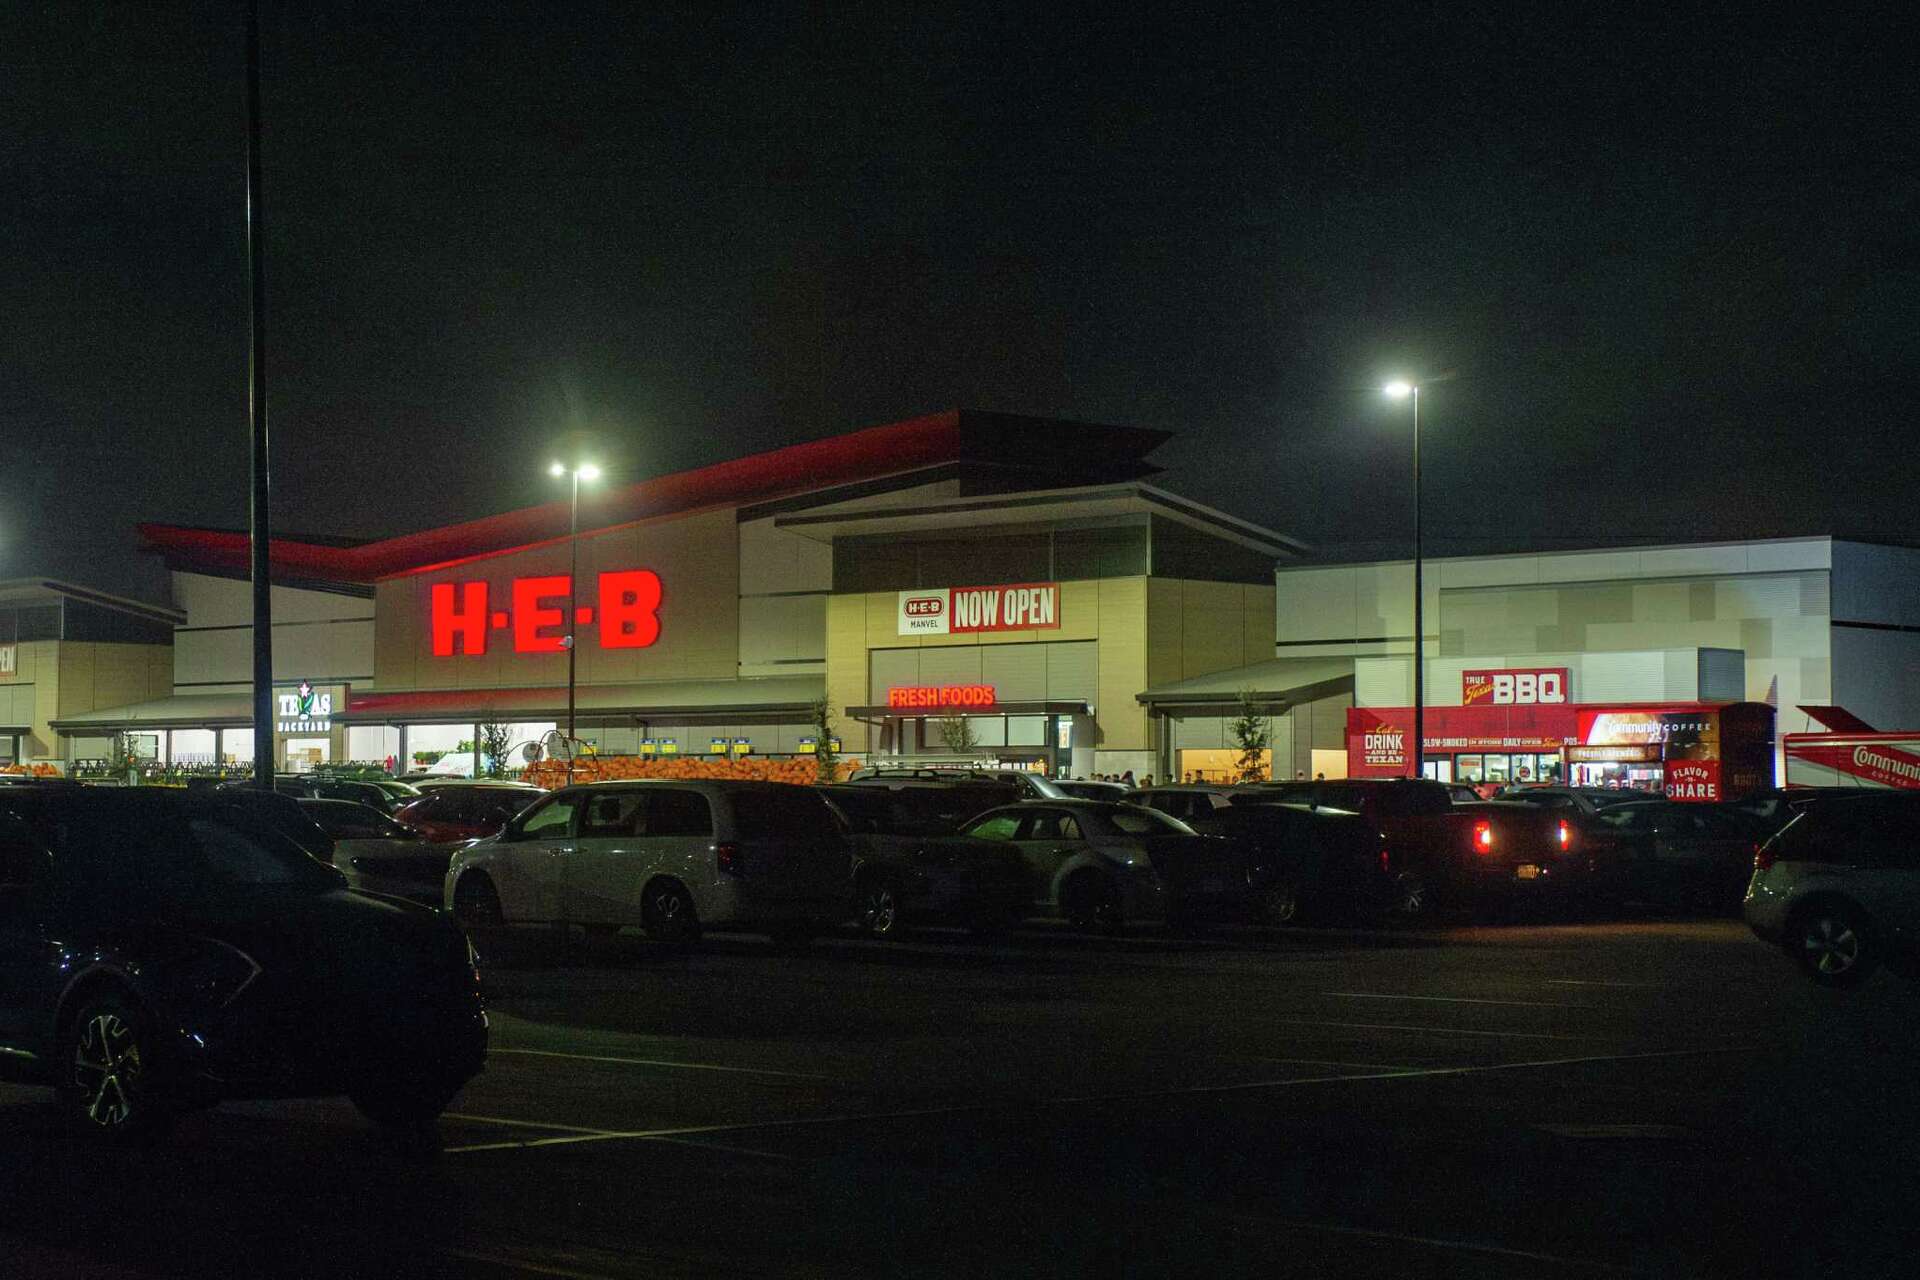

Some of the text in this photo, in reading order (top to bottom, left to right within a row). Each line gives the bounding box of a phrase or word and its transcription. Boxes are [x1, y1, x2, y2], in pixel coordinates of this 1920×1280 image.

[955, 587, 1055, 628] NOW OPEN
[910, 618, 938, 628] MANVEL
[1465, 676, 1485, 684] TRUE
[889, 685, 994, 706] FRESH FOODS
[1493, 673, 1565, 704] BBQ
[278, 721, 331, 731] BACKYARD
[1664, 723, 1711, 731] COFFEE
[1365, 734, 1404, 750] DRINK
[1365, 756, 1404, 764] TEXAN
[1673, 766, 1709, 780] FLAVOR
[1665, 783, 1716, 798] SHARE
